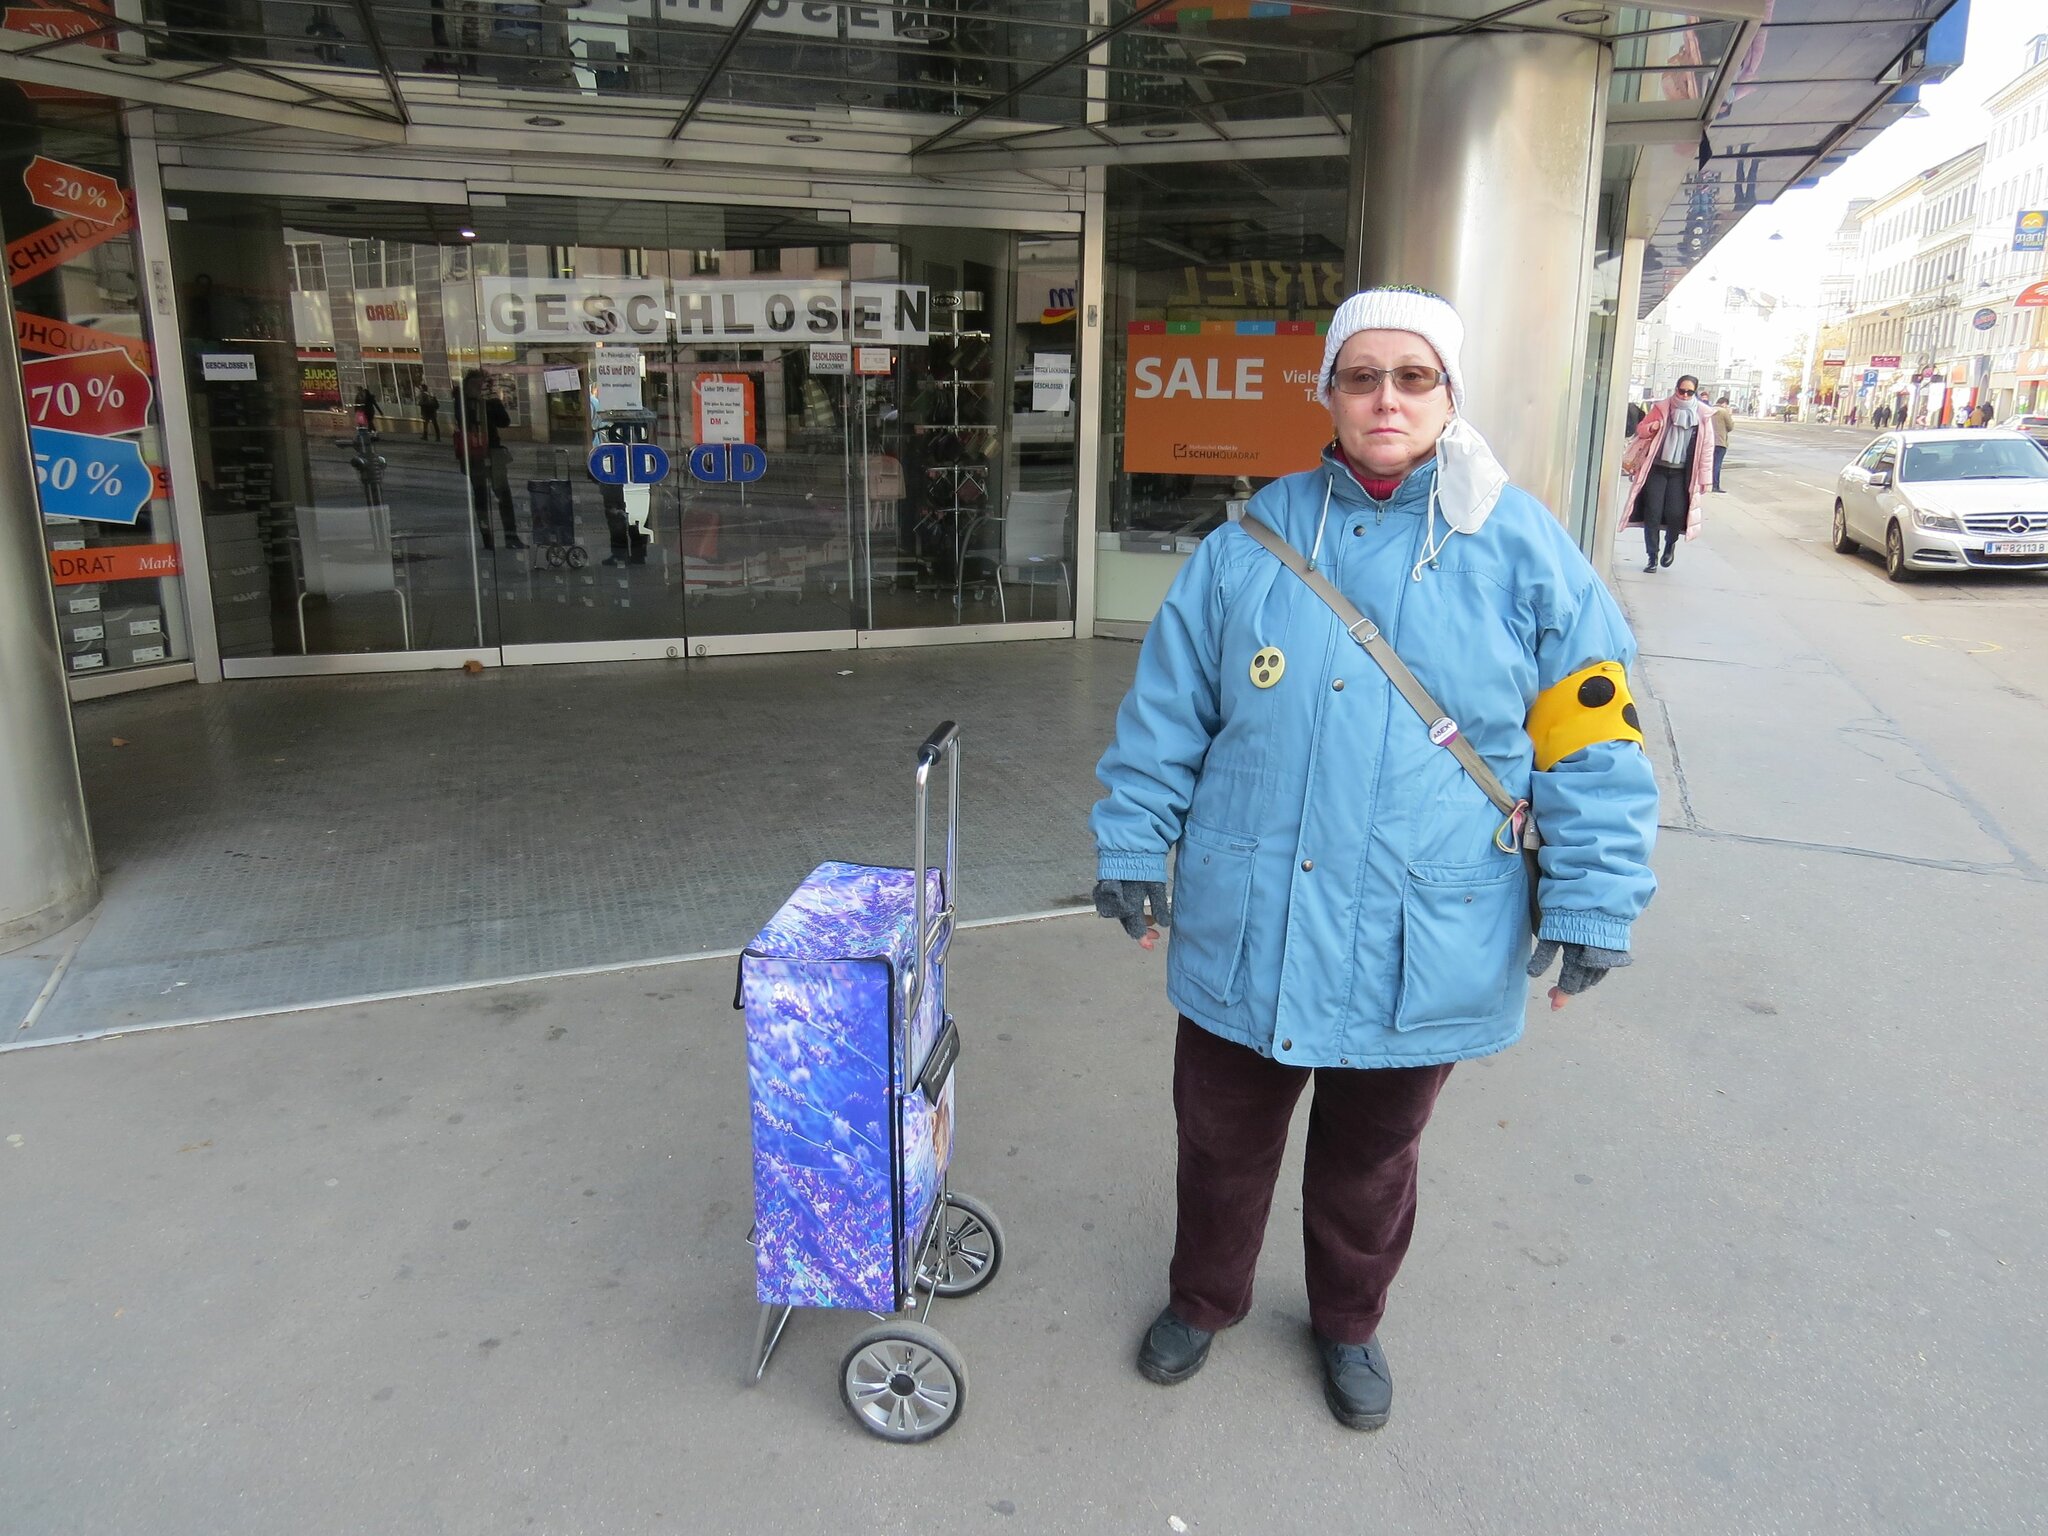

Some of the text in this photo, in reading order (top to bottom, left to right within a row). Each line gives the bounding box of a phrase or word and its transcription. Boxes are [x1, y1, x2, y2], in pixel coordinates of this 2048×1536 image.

[43, 177, 107, 208] -20 %
[490, 289, 927, 339] GESCHLOSEN
[1134, 357, 1264, 400] SALE
[1282, 370, 1319, 384] Viele
[31, 375, 125, 422] 70 %
[1188, 450, 1259, 460] SCHUHQUADRAT
[86, 461, 123, 496] %
